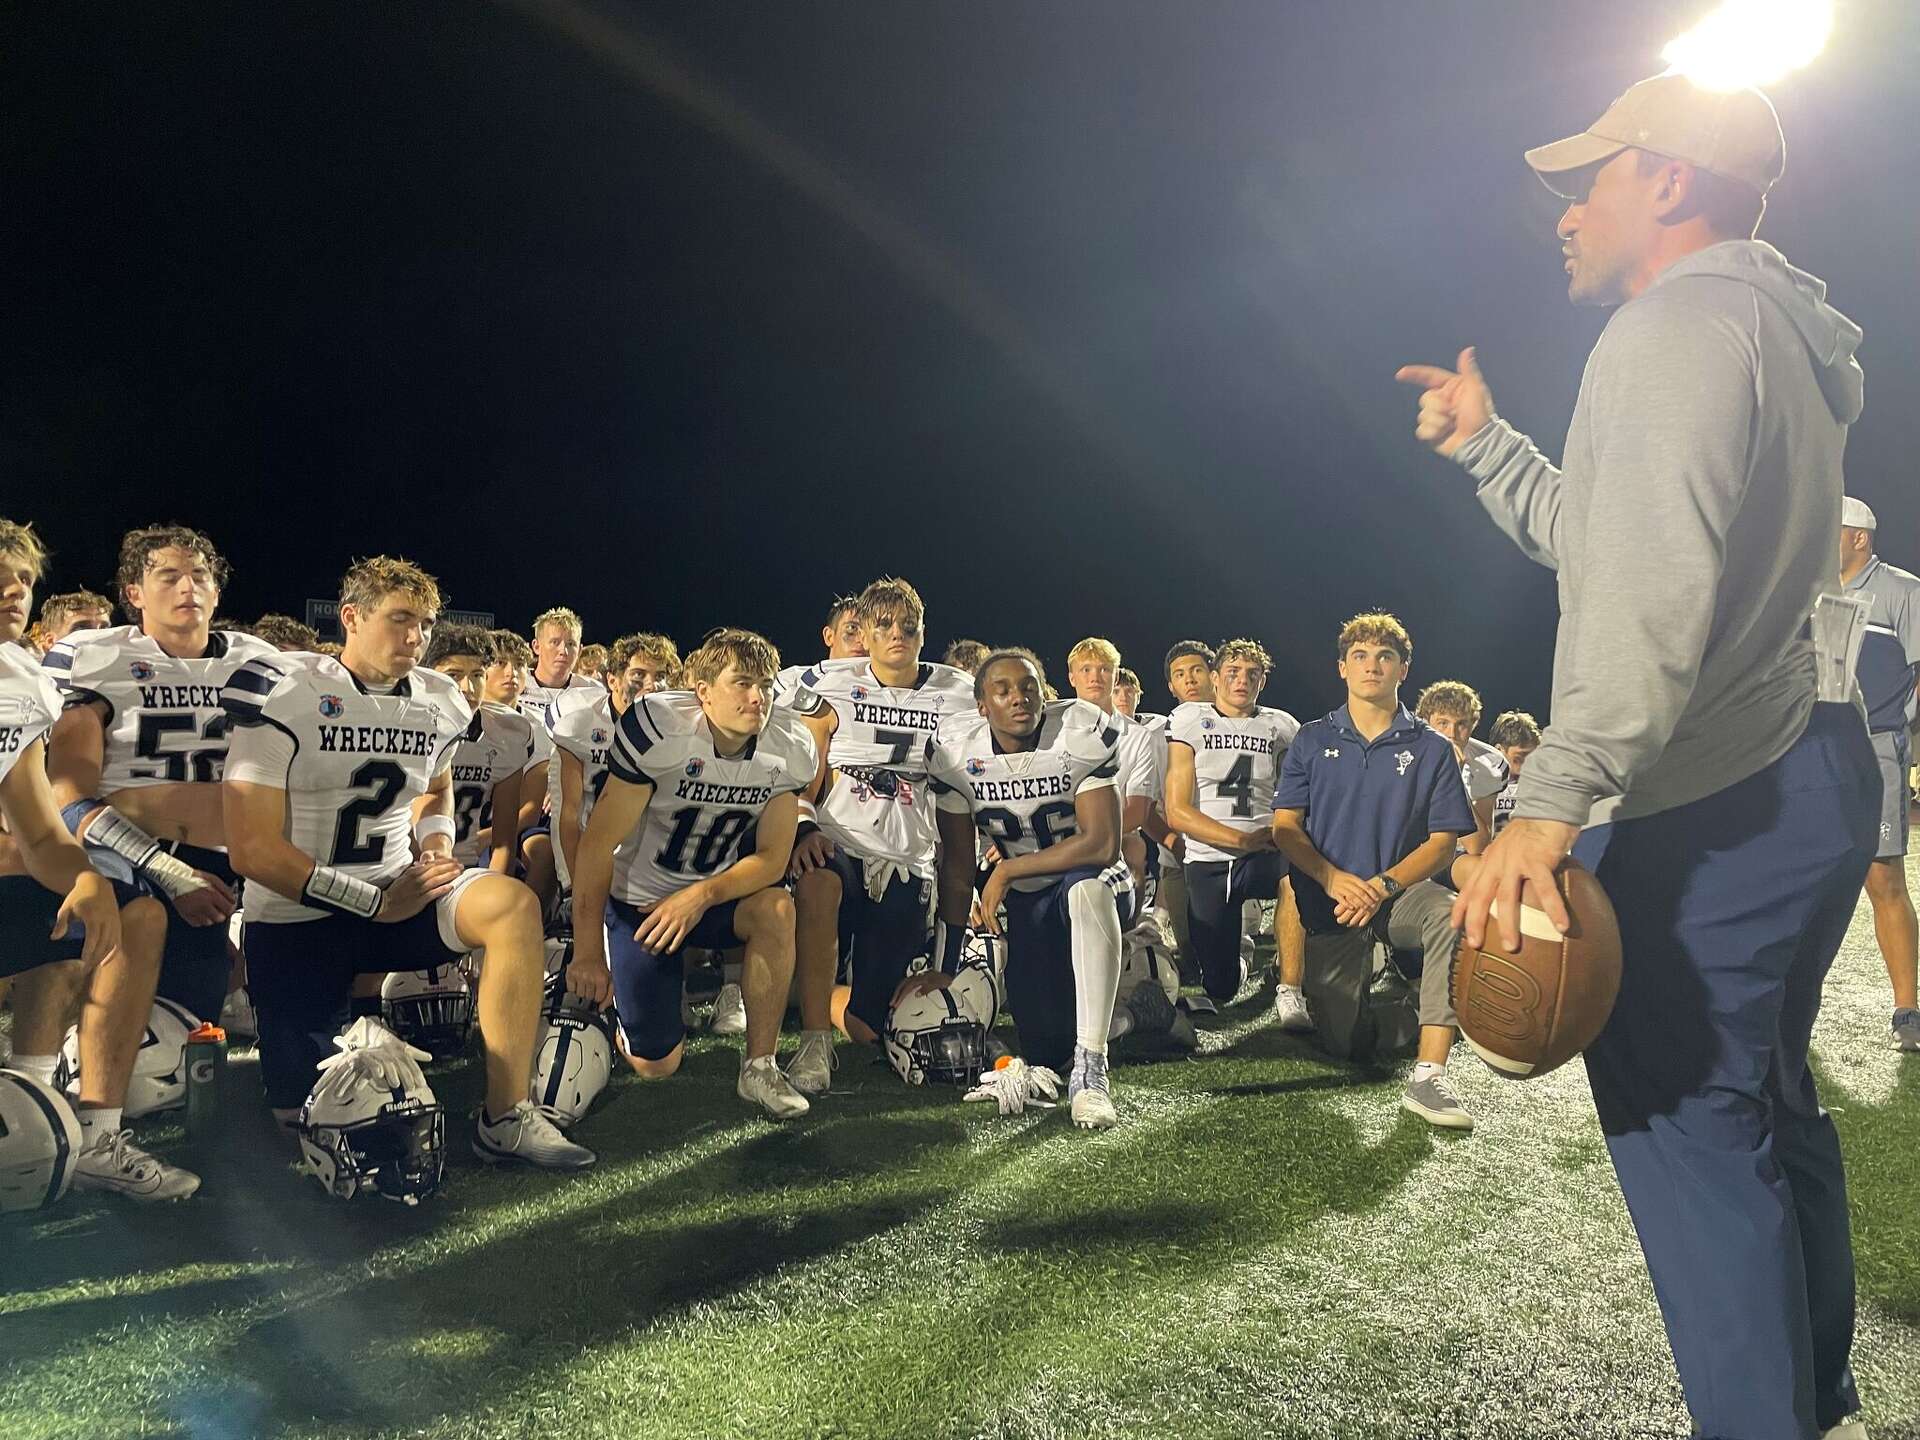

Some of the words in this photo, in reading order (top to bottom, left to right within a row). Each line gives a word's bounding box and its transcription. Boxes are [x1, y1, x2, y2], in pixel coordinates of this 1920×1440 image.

[314, 604, 338, 616] HO
[853, 703, 940, 730] WRECKERS
[318, 725, 437, 756] WRECKERS
[874, 728, 917, 765] 7
[1202, 734, 1275, 755] WRECKERS
[452, 765, 492, 782] KERS
[1216, 754, 1256, 817] 4
[675, 780, 771, 805] WRECKERS
[969, 774, 1072, 801] WRECKERS
[329, 758, 407, 866] 2
[385, 1098, 420, 1113] Riddell
